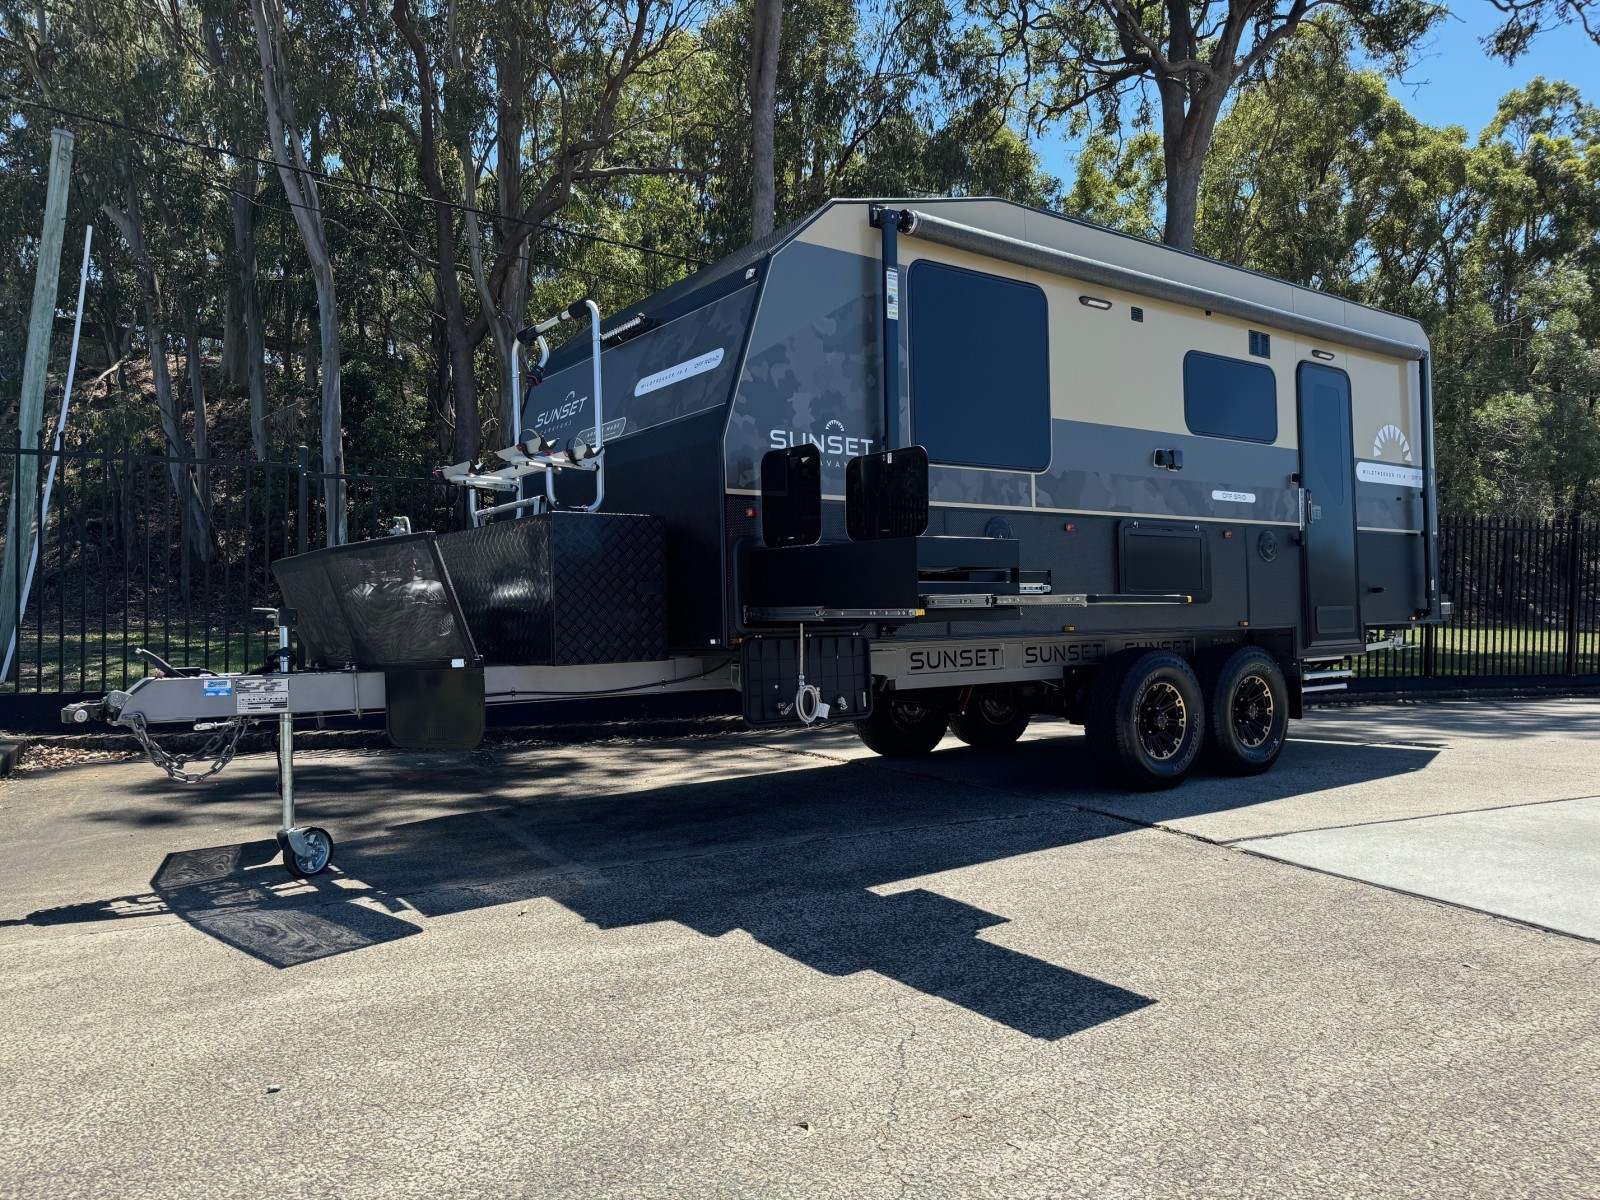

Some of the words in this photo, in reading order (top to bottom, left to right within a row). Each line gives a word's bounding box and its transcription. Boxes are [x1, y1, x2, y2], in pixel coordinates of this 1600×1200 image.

[535, 396, 588, 429] SUNSET
[769, 429, 874, 457] SUNSET
[1222, 492, 1233, 500] OFF
[1233, 493, 1246, 501] GRID
[910, 648, 1001, 670] SUNSET
[1025, 643, 1102, 665] SUNSET
